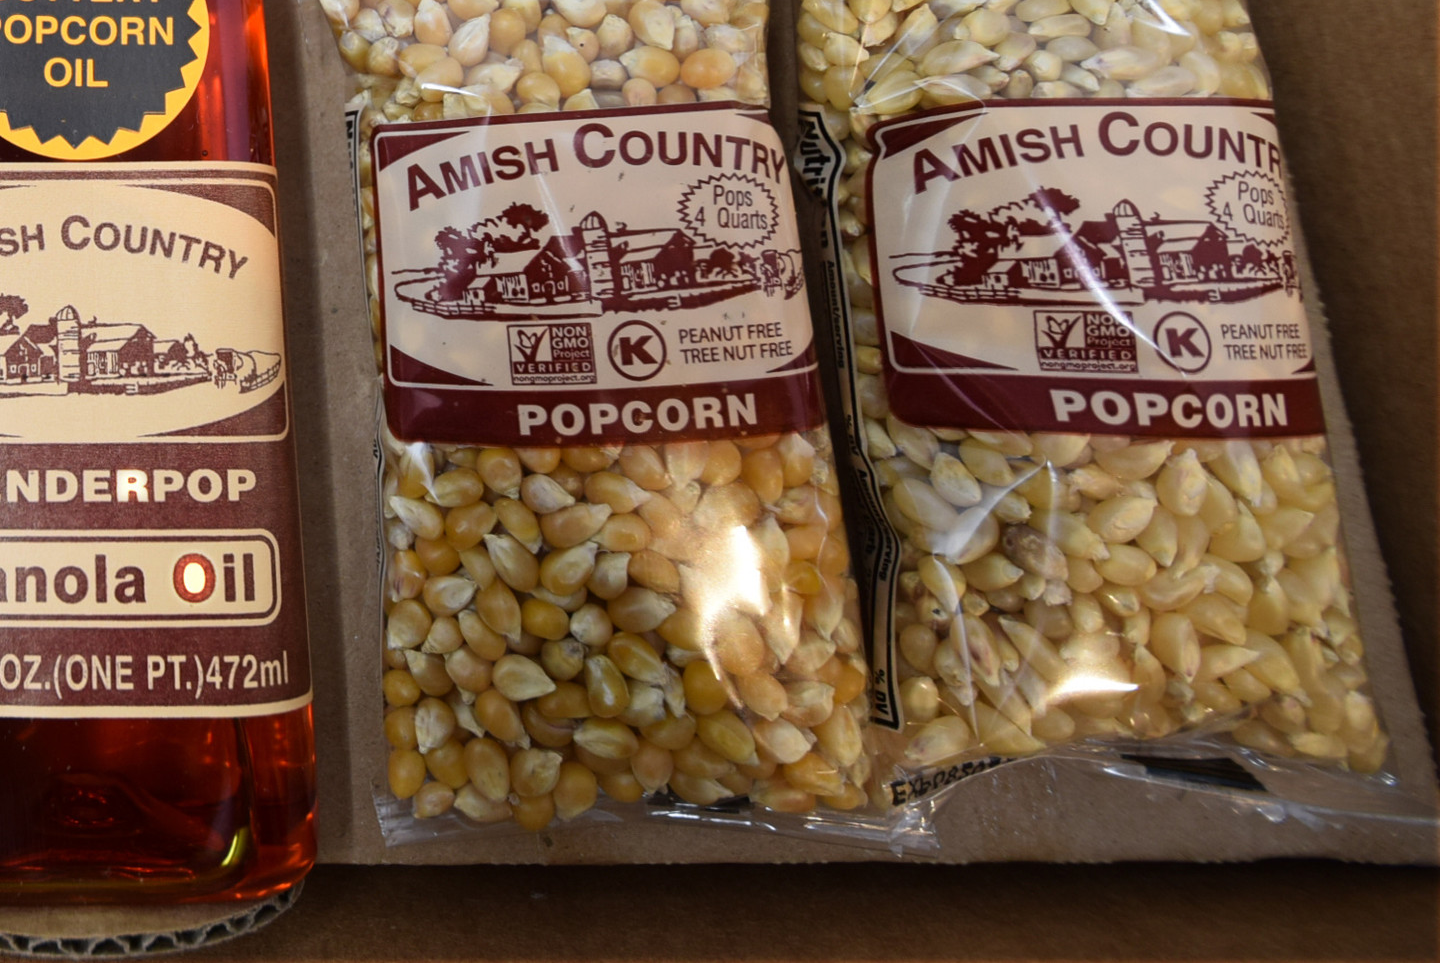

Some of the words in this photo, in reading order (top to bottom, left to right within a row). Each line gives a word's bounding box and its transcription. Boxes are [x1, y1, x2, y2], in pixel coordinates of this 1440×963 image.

[43, 58, 109, 87] OIL
[407, 138, 561, 211] AMISH
[572, 122, 786, 184] COUNTRY
[912, 123, 1084, 195] AMISH
[713, 183, 753, 208] Pops
[1238, 181, 1273, 205] Pops
[694, 206, 707, 227] 4
[716, 206, 768, 230] Quarts
[1222, 202, 1233, 221] 4
[61, 215, 249, 280] COUNTRY
[552, 326, 587, 337] NON
[552, 338, 589, 348] GMO
[678, 325, 744, 344] PEANUT
[747, 322, 782, 338] FREE
[1086, 326, 1130, 336] GMO
[1165, 327, 1205, 359] K
[1221, 324, 1273, 340] PEANUT
[1276, 324, 1300, 338] FREE
[618, 334, 659, 366] K
[680, 348, 720, 364] TREE
[723, 345, 758, 362] NUT
[760, 340, 793, 358] FREE
[1042, 349, 1132, 360] VERIFIED
[1223, 344, 1256, 360] TREE
[1260, 344, 1284, 360] NUT
[1287, 344, 1308, 359] FREE
[516, 393, 758, 436] POPCORN
[1049, 389, 1288, 429] POPCORN
[172, 552, 256, 603] Oil
